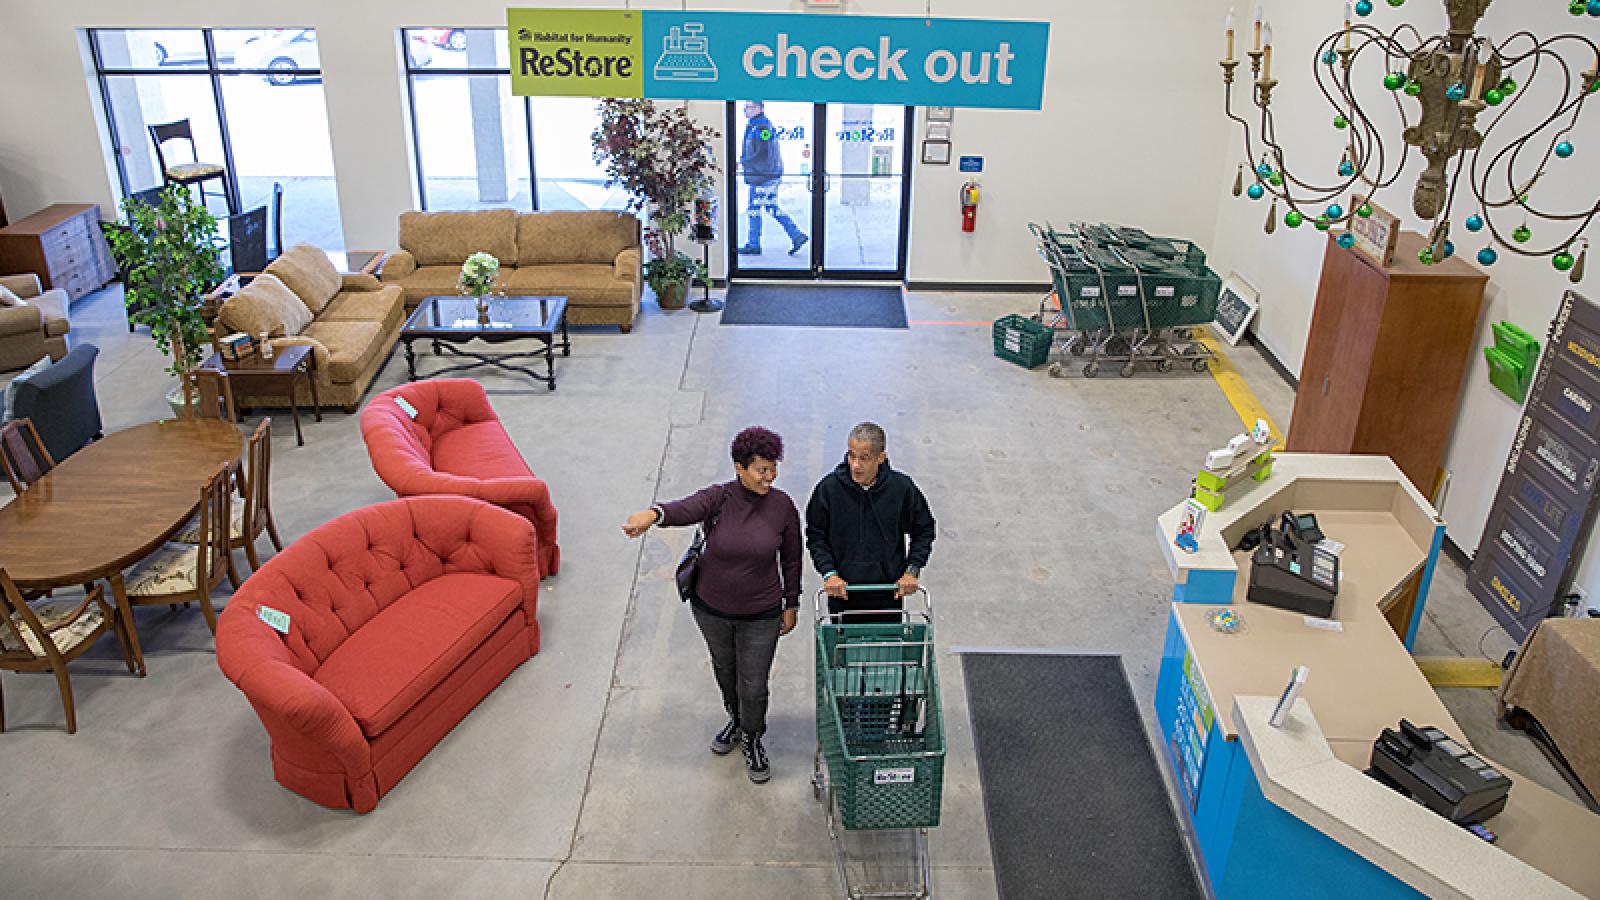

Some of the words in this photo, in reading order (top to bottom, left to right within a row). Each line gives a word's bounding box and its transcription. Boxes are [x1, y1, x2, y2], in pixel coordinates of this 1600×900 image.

[534, 32, 569, 42] Habitat
[570, 32, 584, 42] for
[586, 33, 632, 46] Humanity
[520, 47, 632, 78] ReStore
[742, 33, 908, 81] check
[924, 42, 1014, 85] out
